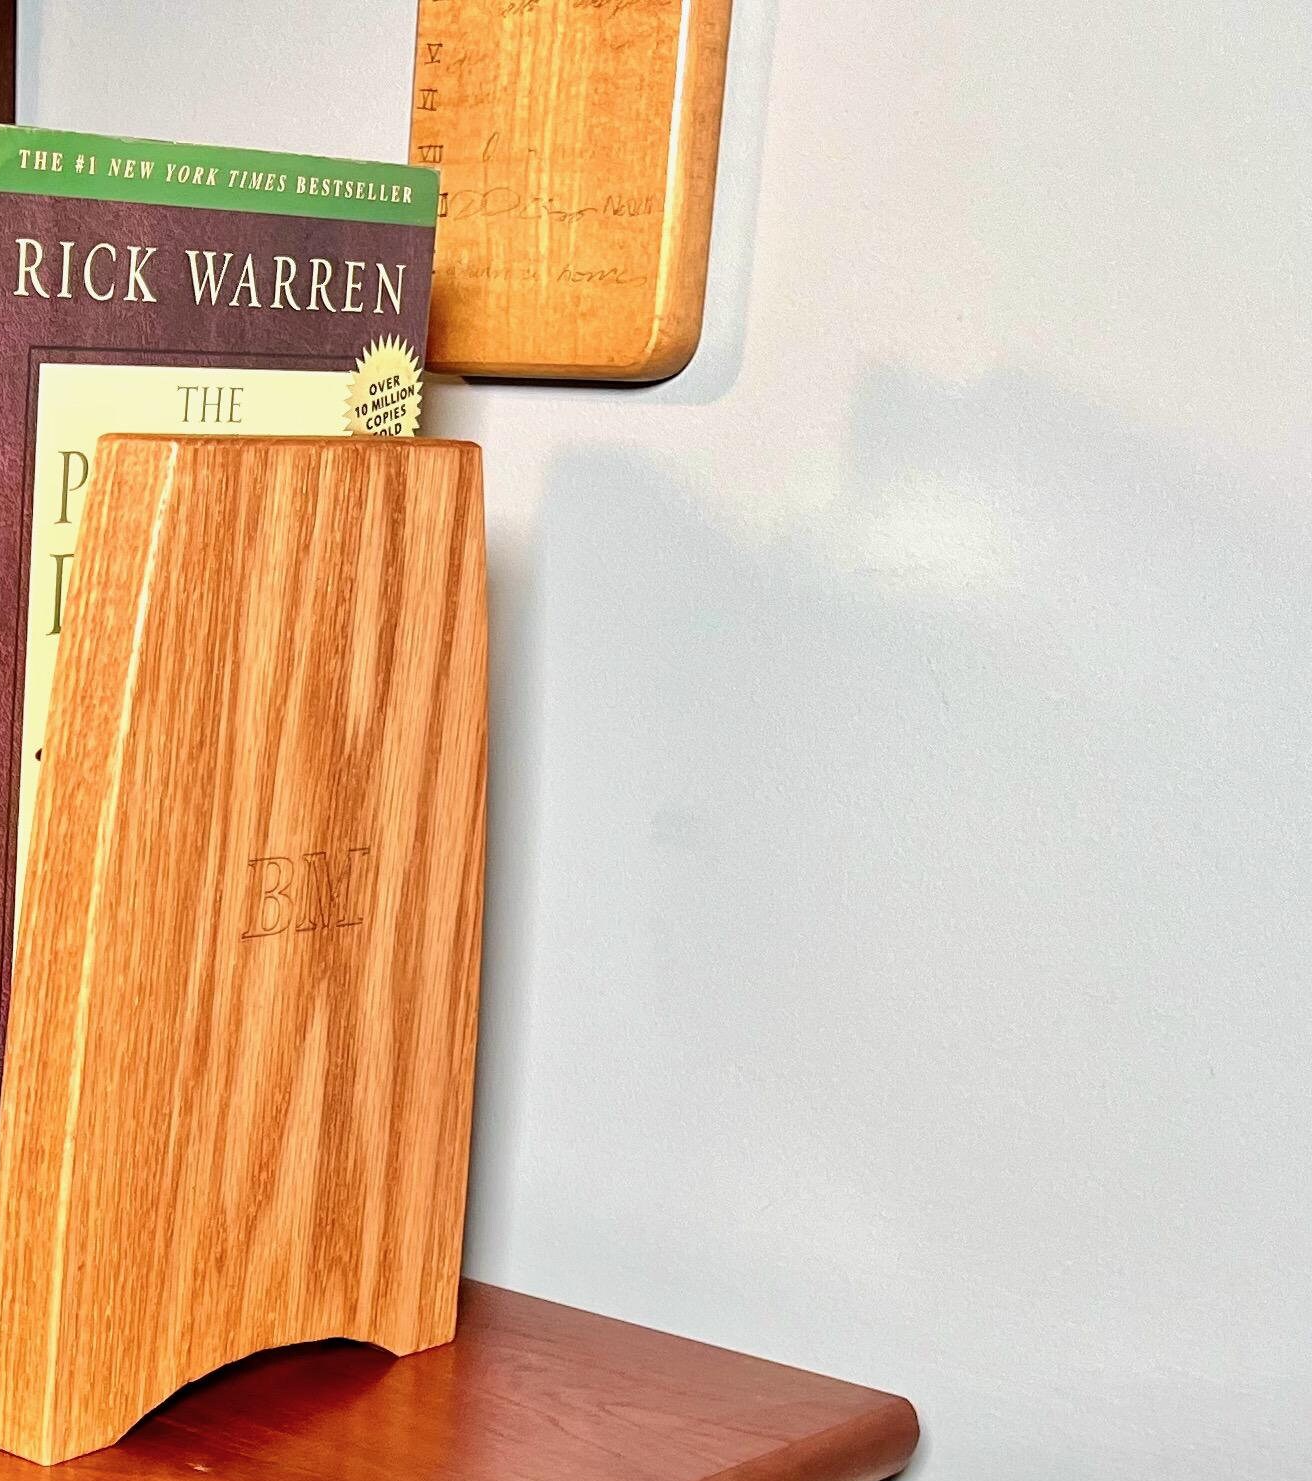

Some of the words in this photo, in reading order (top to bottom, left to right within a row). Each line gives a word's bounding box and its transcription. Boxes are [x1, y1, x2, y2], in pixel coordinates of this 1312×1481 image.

[423, 42, 444, 66] V
[416, 88, 439, 112] VI
[417, 143, 445, 165] VII
[18, 148, 64, 174] THE
[74, 154, 98, 177] #1
[107, 158, 157, 181] NEW
[165, 164, 219, 187] YORK
[228, 169, 287, 193] TIMES
[295, 174, 414, 205] BESTSELLER
[13, 237, 159, 303] RICK
[184, 248, 408, 316] WARREN
[369, 375, 401, 396] OVER
[176, 384, 245, 425] THE
[354, 403, 368, 418] 10
[371, 384, 415, 412] MILLION
[365, 403, 407, 430] COPIES
